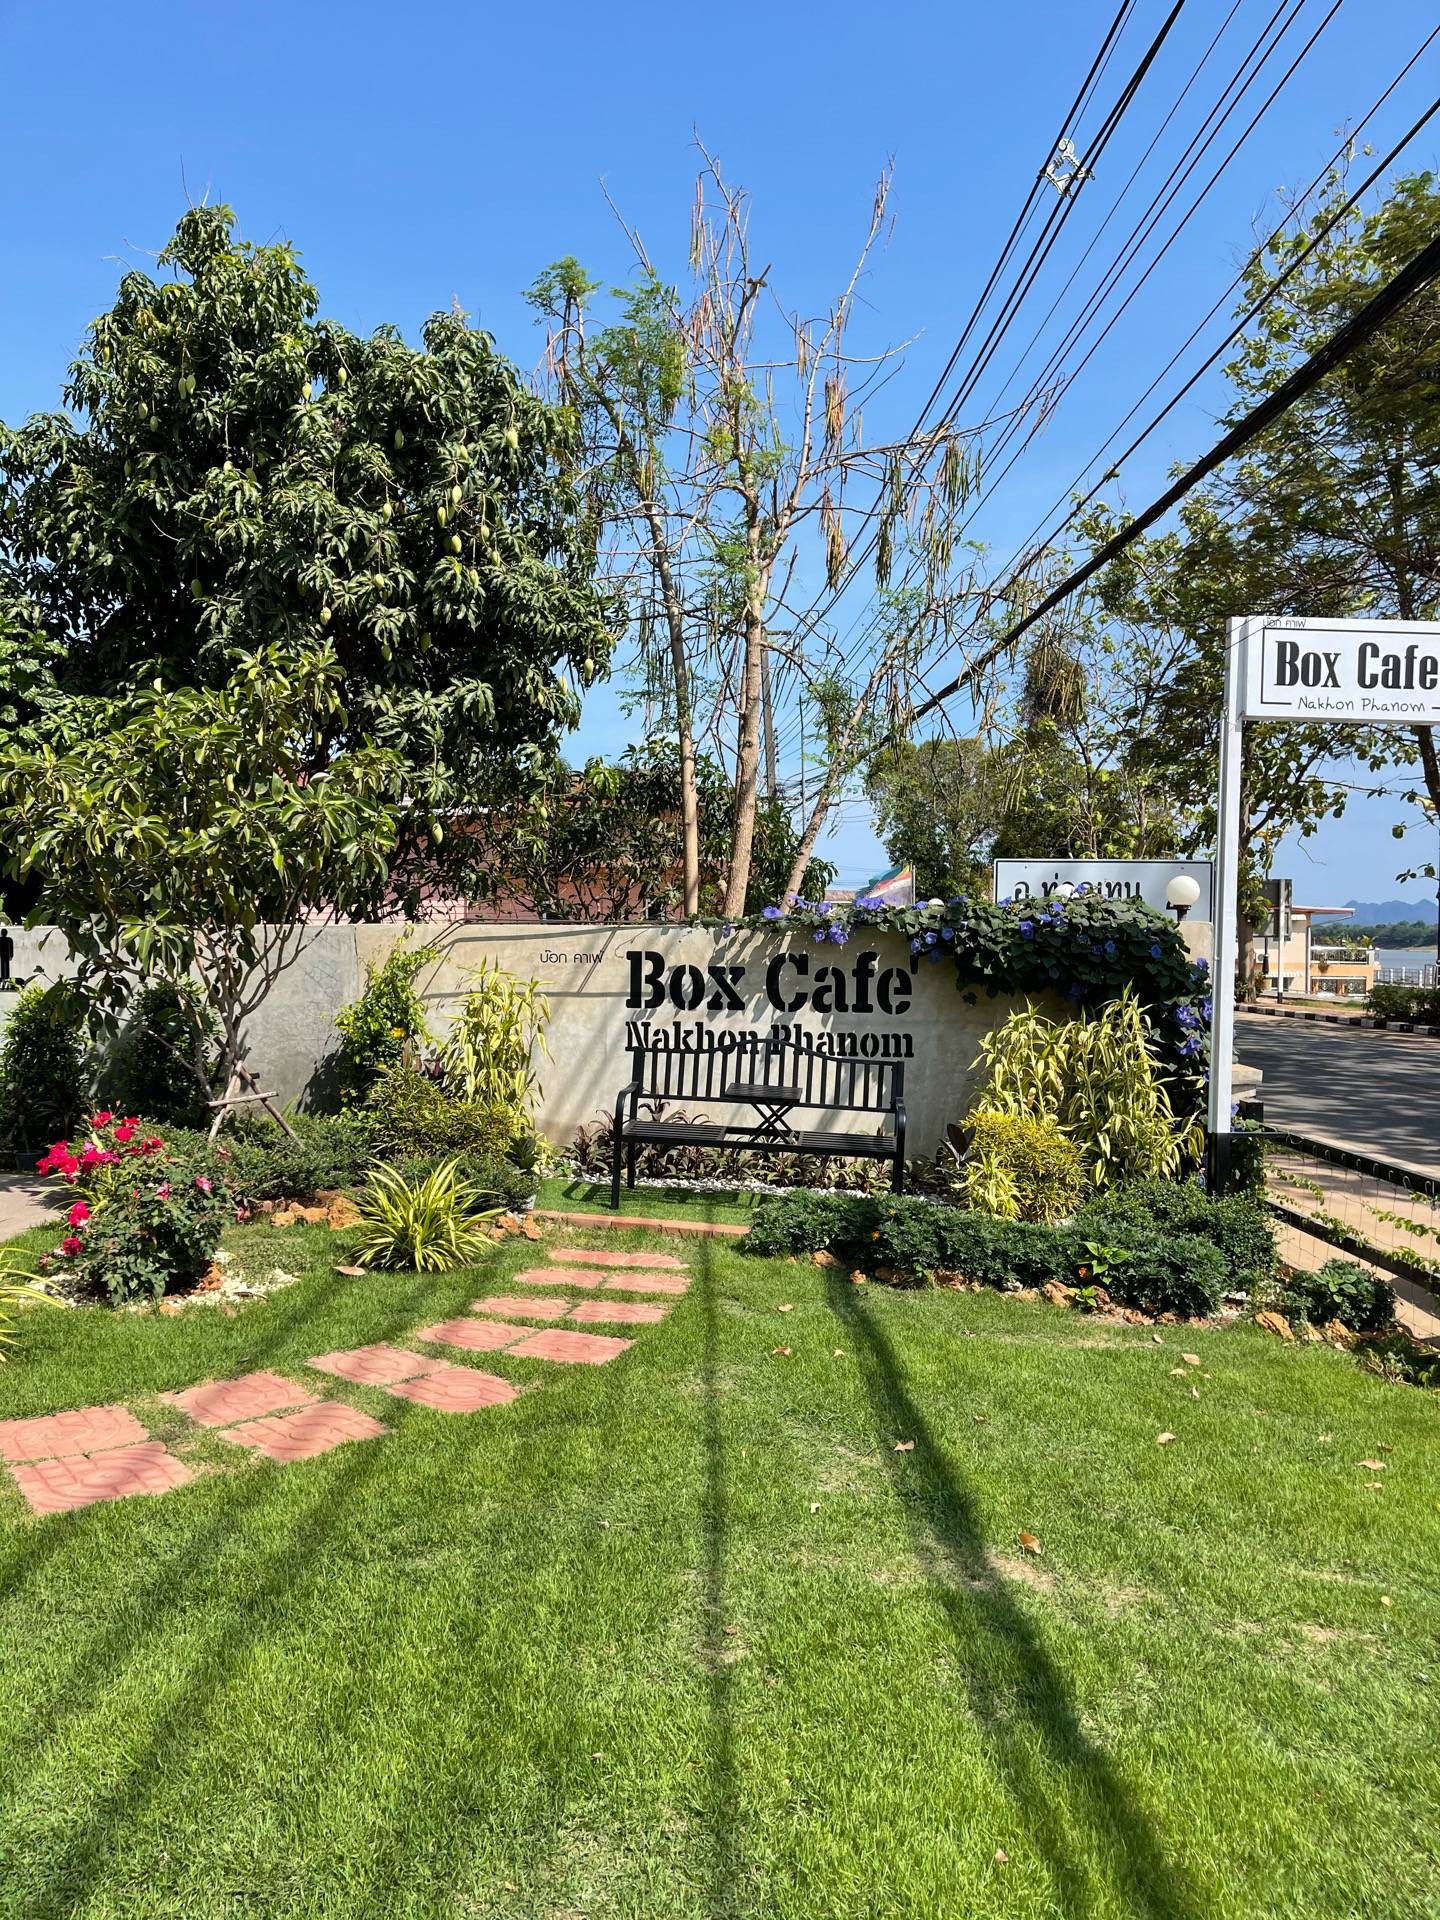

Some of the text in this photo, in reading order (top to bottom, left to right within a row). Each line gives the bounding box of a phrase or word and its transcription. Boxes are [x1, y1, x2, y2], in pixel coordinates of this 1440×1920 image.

[1274, 640, 1439, 690] Box Cafe
[1298, 695, 1426, 713] Nakhon Phanom
[625, 950, 746, 1011] Box
[625, 1021, 915, 1059] Nakhon Phanom
